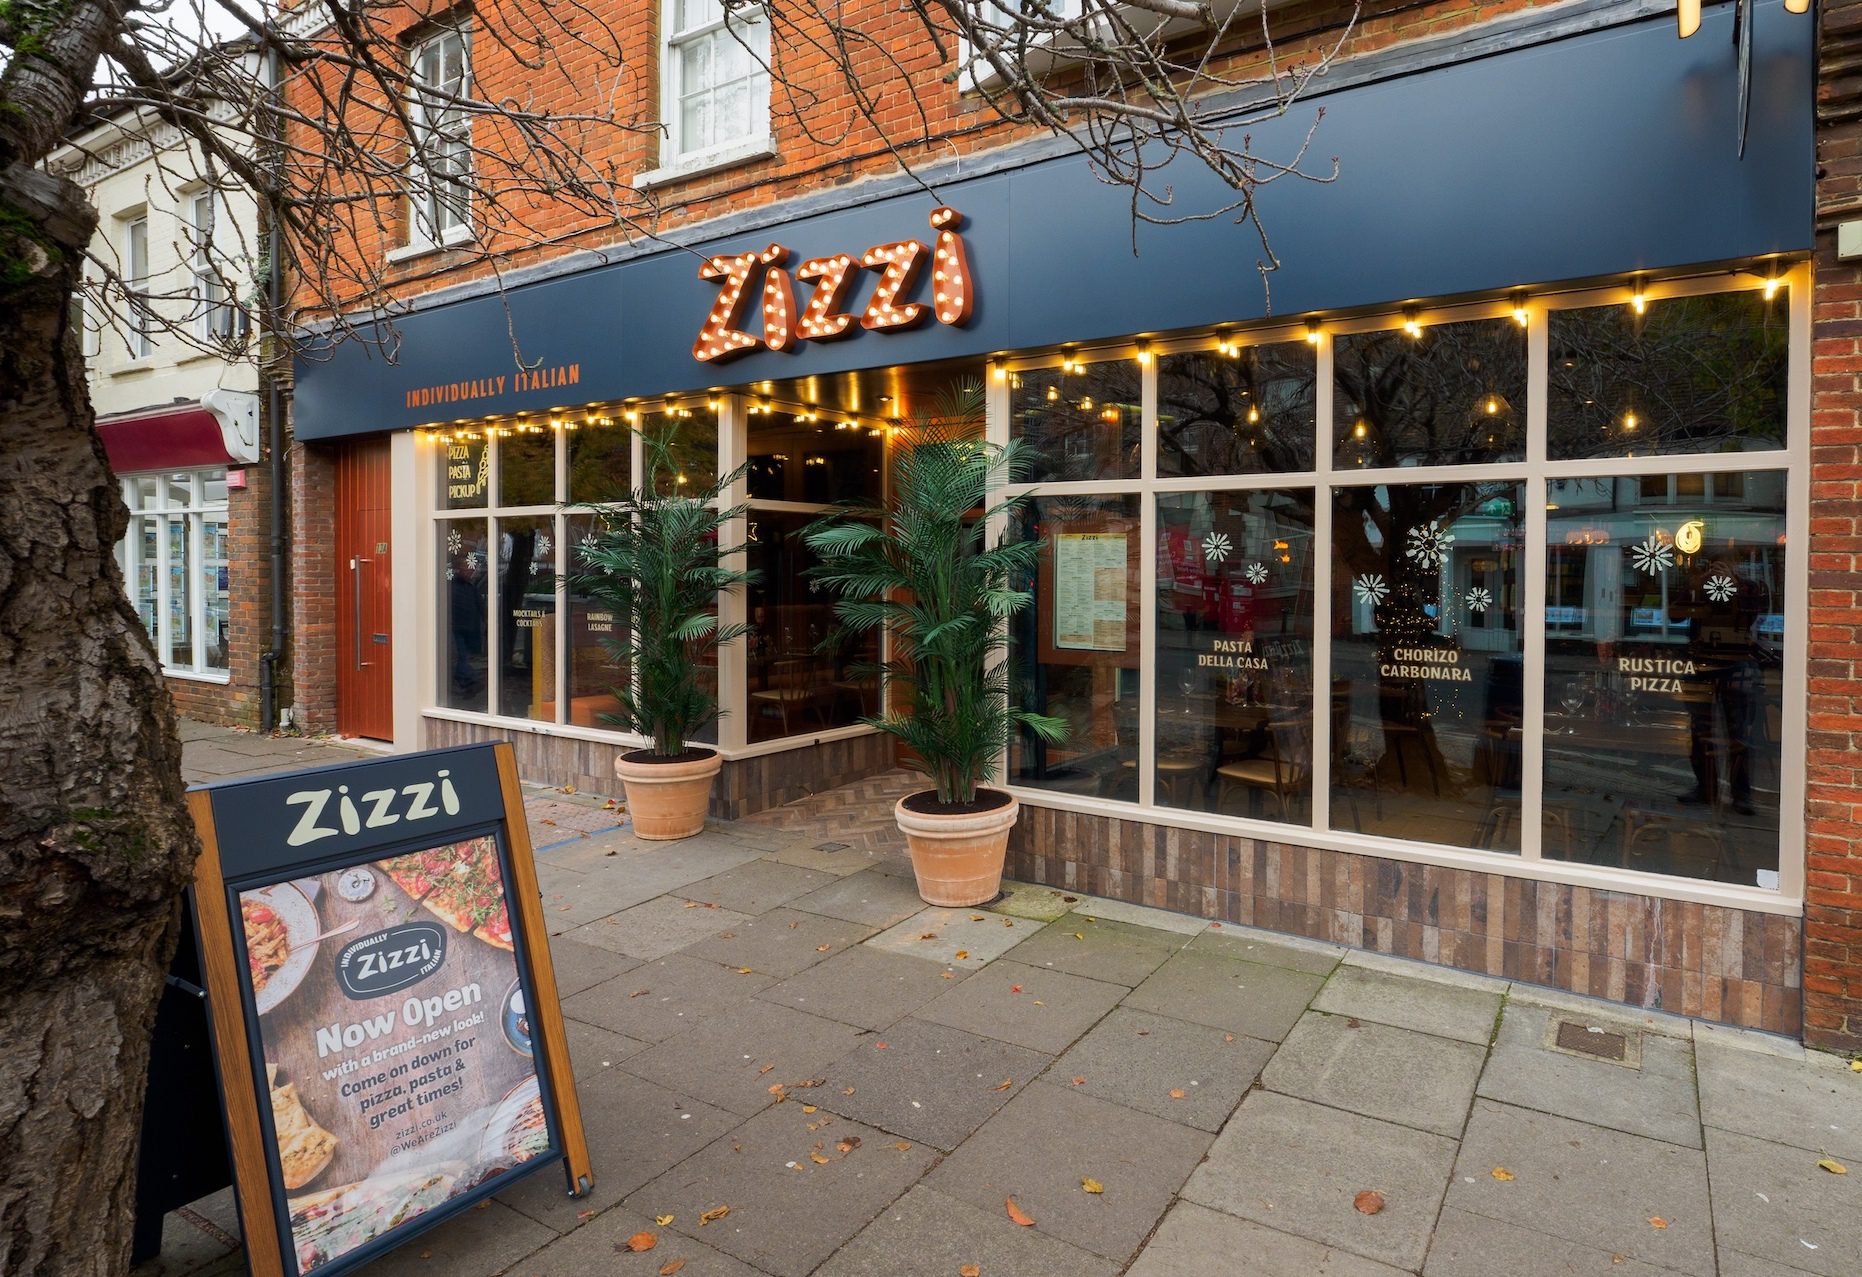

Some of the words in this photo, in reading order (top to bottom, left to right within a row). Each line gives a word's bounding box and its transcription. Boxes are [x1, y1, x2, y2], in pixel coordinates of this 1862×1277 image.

[692, 206, 973, 362] Zizzi
[406, 376, 505, 408] INDIVIDUALLY
[514, 364, 580, 392] ITALIAN
[448, 445, 470, 460] PIZZA
[448, 465, 471, 480] PASTA
[448, 484, 476, 499] PICKUP
[586, 612, 613, 622] RAINBOW
[587, 623, 613, 632] LASAGNE
[1213, 639, 1252, 653] PASTA
[1393, 648, 1458, 663] CHORIZO
[1198, 654, 1233, 668] DELLA
[1237, 656, 1268, 670] CASA
[1381, 664, 1473, 681] CARBONARA
[1619, 657, 1696, 675] RUSTICA
[1631, 677, 1682, 693] PIZZA
[286, 769, 460, 847] Zizzi
[341, 933, 388, 968] INDIVIDUALLY
[357, 938, 431, 980] Zizzi
[420, 949, 442, 975] ITALIAN
[316, 1011, 396, 1058] Now
[402, 982, 482, 1027] Open
[322, 1058, 359, 1081] with
[361, 1056, 371, 1067] a
[373, 1024, 451, 1063] brand-new
[453, 1011, 485, 1033] look!
[341, 1072, 387, 1097] Come
[389, 1062, 408, 1079] on
[411, 1045, 452, 1071] down
[454, 1036, 476, 1053] for
[359, 1085, 407, 1114] pizza,
[409, 1064, 452, 1094] pasta
[455, 1058, 466, 1072] &
[370, 1099, 414, 1130] great
[416, 1077, 463, 1106] times!
[390, 1120, 457, 1158] @WeAreZizzi
[395, 1110, 448, 1140] zizzi.co.uk
